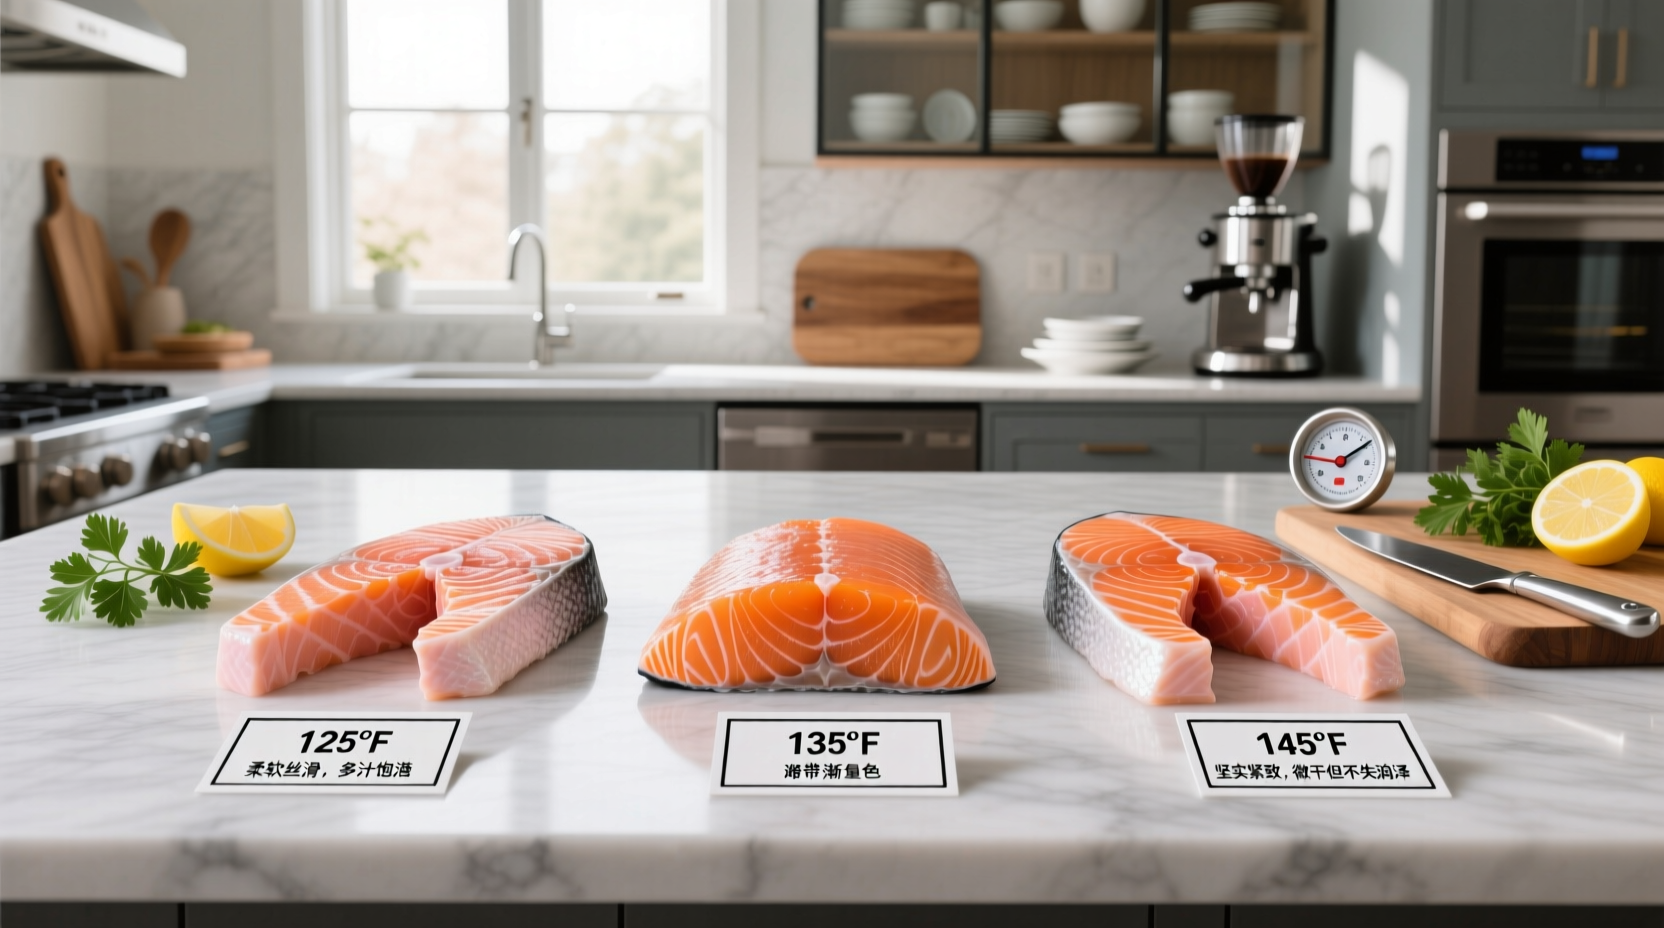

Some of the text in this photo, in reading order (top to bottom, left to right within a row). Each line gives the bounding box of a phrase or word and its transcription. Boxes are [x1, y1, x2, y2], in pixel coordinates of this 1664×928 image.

[300, 729, 394, 754] 125°F
[788, 730, 881, 756] 135°F
[1256, 731, 1347, 756] 145°F
